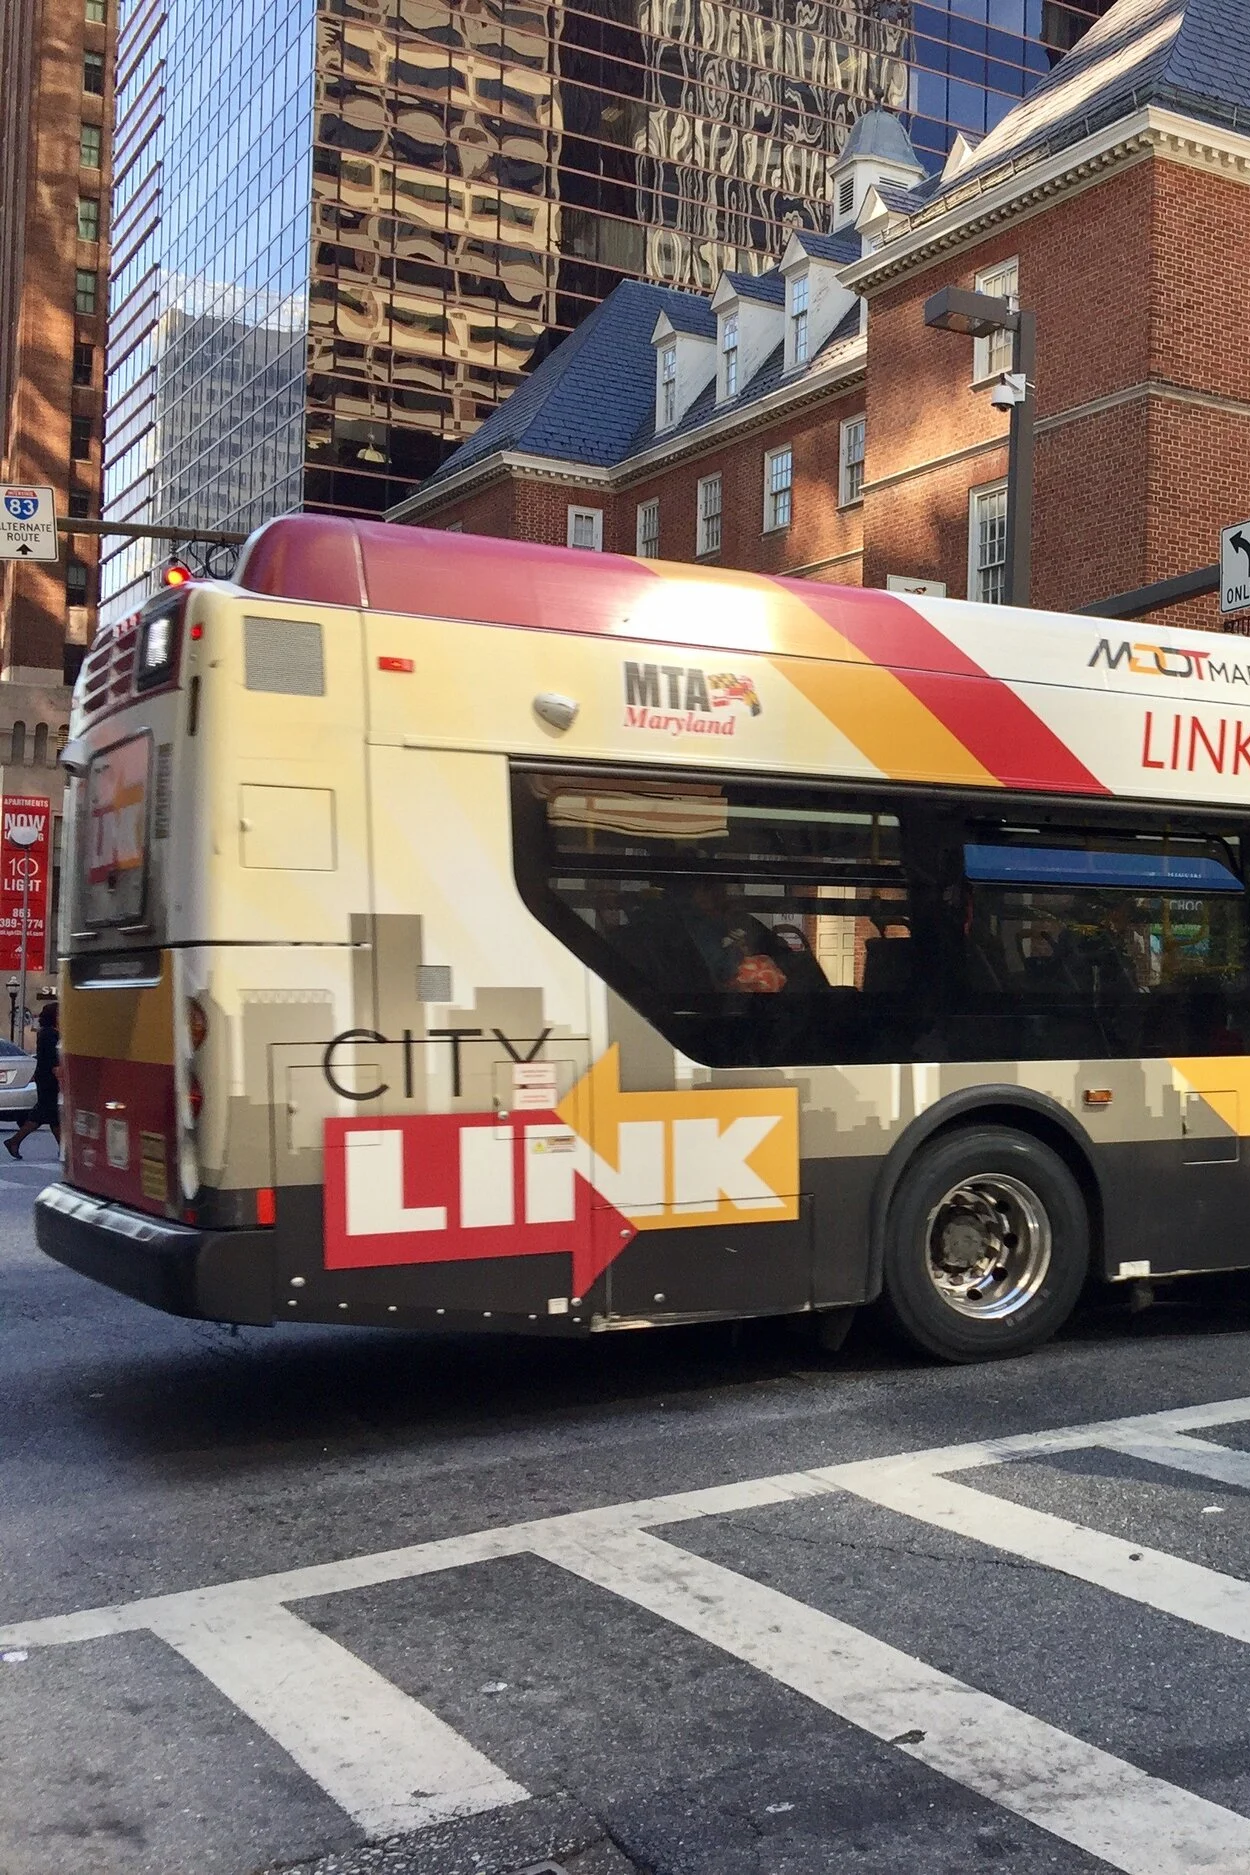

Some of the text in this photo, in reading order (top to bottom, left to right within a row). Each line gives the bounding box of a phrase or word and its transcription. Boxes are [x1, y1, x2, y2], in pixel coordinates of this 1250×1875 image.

[9, 499, 34, 516] 83
[0, 522, 53, 533] LTERNATE
[7, 532, 40, 542] ROUTE
[624, 661, 712, 713] MTA
[623, 706, 736, 737] Maryland
[4, 798, 49, 808] APARTMENTS
[4, 813, 46, 832] NOW
[9, 857, 39, 877] 10
[323, 1028, 554, 1101] CITY
[344, 1115, 788, 1237] LINK
